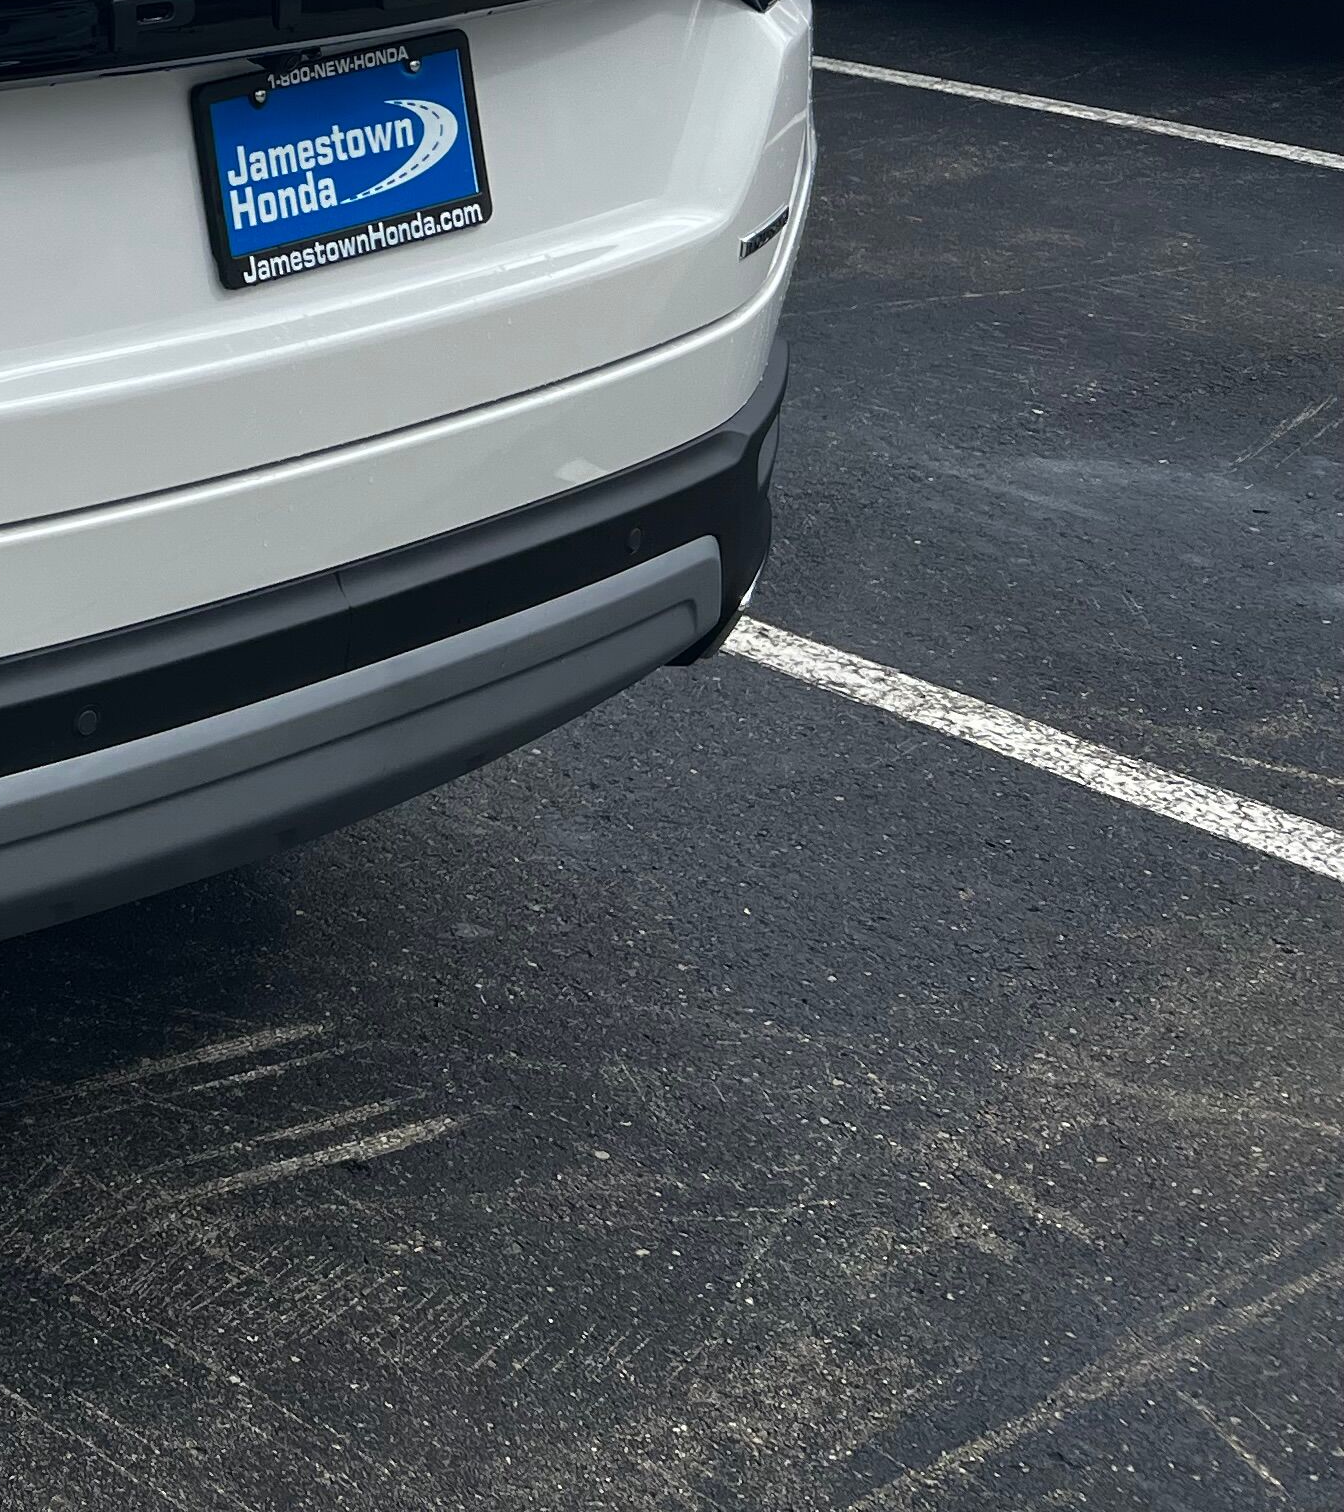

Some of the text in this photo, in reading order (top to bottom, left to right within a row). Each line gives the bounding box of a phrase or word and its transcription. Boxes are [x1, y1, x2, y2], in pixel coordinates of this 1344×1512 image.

[267, 45, 410, 89] 1-800-NEW-HONDA
[226, 117, 416, 187] Jamestown
[229, 171, 339, 231] Honda
[242, 201, 484, 285] JamestownHonda.com
